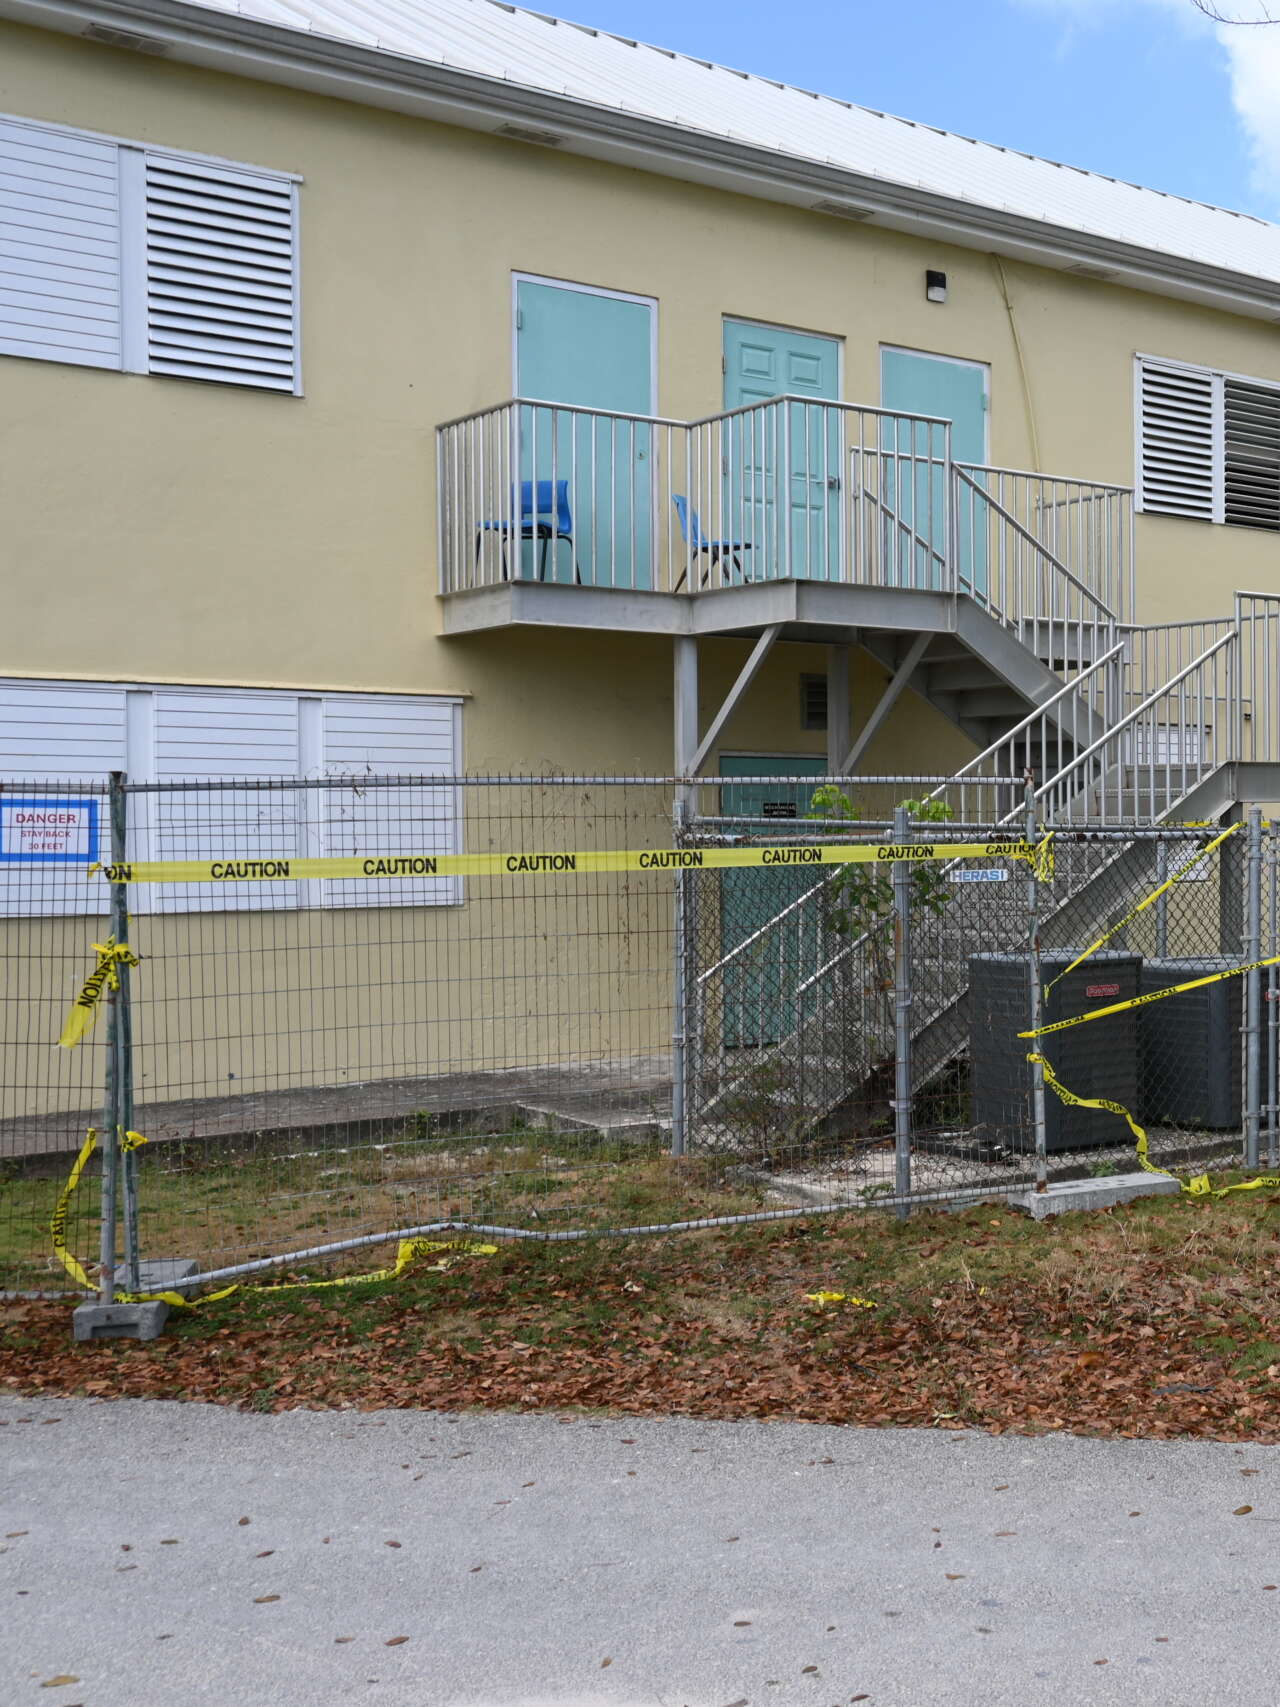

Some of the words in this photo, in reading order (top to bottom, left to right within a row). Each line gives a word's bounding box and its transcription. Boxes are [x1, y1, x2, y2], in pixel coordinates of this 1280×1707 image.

[15, 813, 76, 824] DANGER
[20, 830, 45, 838] STAY
[45, 830, 72, 838] BACK
[42, 842, 64, 850] FEET
[210, 861, 290, 879] CAUTION
[362, 857, 437, 875] CAUTION
[506, 854, 576, 872] CAUTION
[639, 851, 703, 868] CAUTION
[762, 848, 822, 864] CAUTION
[877, 845, 934, 860] CAUTION
[985, 844, 1037, 855] CAUTION
